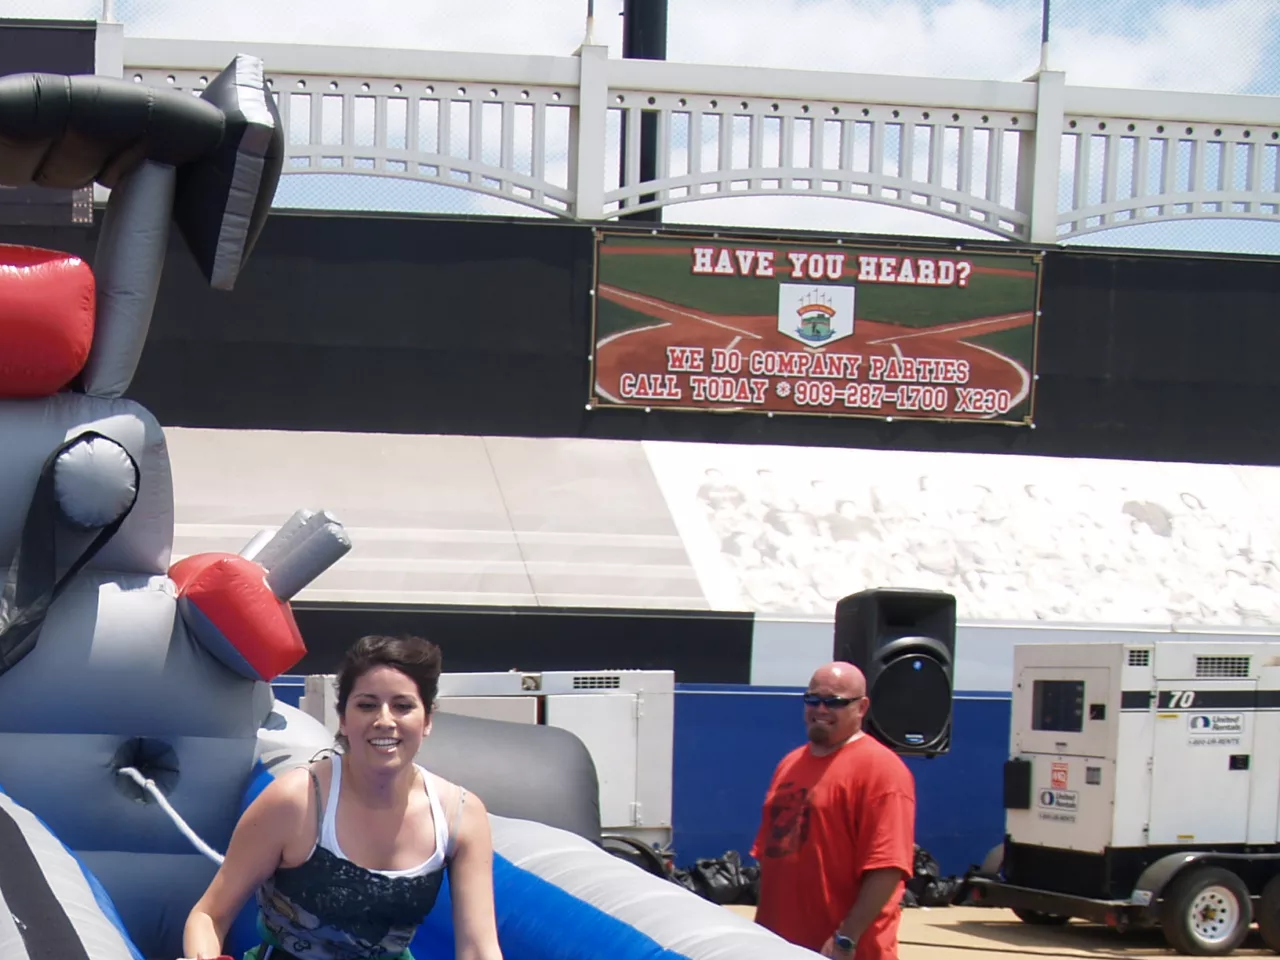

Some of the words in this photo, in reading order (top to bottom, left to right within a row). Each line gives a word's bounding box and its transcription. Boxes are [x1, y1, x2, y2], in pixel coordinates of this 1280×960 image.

[692, 246, 775, 277] HAVE
[787, 252, 846, 279] YOU
[857, 255, 972, 287] HEARD?
[666, 346, 705, 372] WE
[711, 348, 742, 374] DO
[748, 350, 862, 380] COMPANY
[869, 355, 970, 384] PARTIES
[620, 373, 682, 400] CALL
[690, 375, 769, 404] TODAY
[794, 381, 948, 411] 909-287-1700
[954, 386, 1012, 414] X230
[1168, 691, 1195, 708] 70
